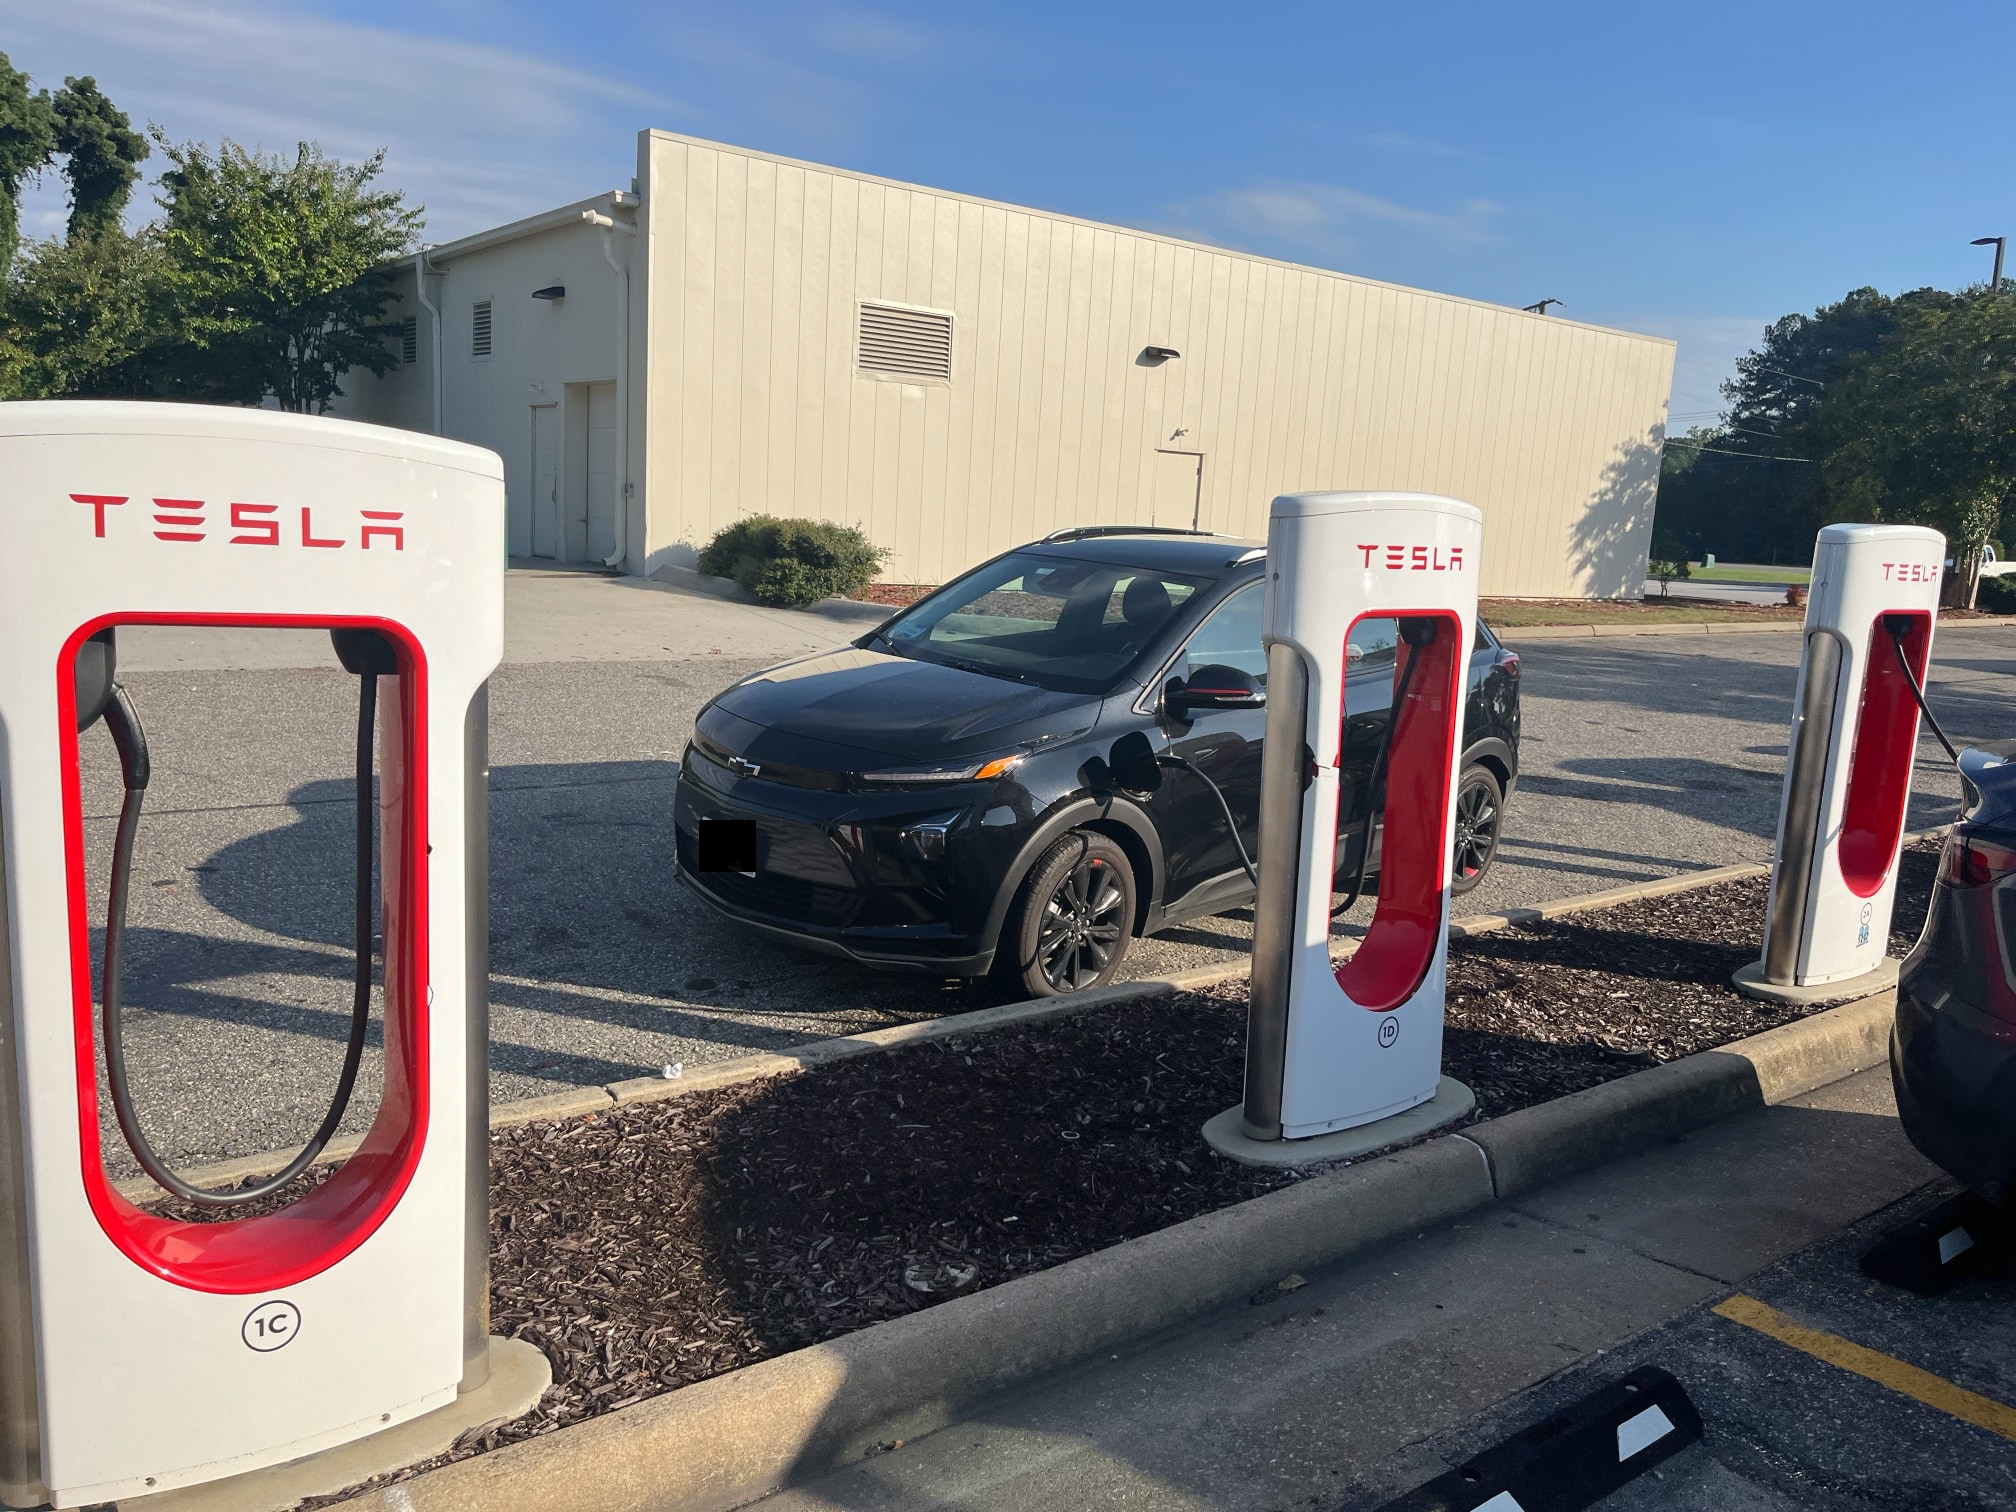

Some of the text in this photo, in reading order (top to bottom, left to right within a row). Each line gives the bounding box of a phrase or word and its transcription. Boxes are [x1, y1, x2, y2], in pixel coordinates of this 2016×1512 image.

[68, 493, 404, 550] TESLA
[1356, 544, 1463, 571] TESLA
[1882, 563, 1938, 582] TESLA
[1383, 1025, 1395, 1038] 1D
[254, 1313, 288, 1337] 1C
